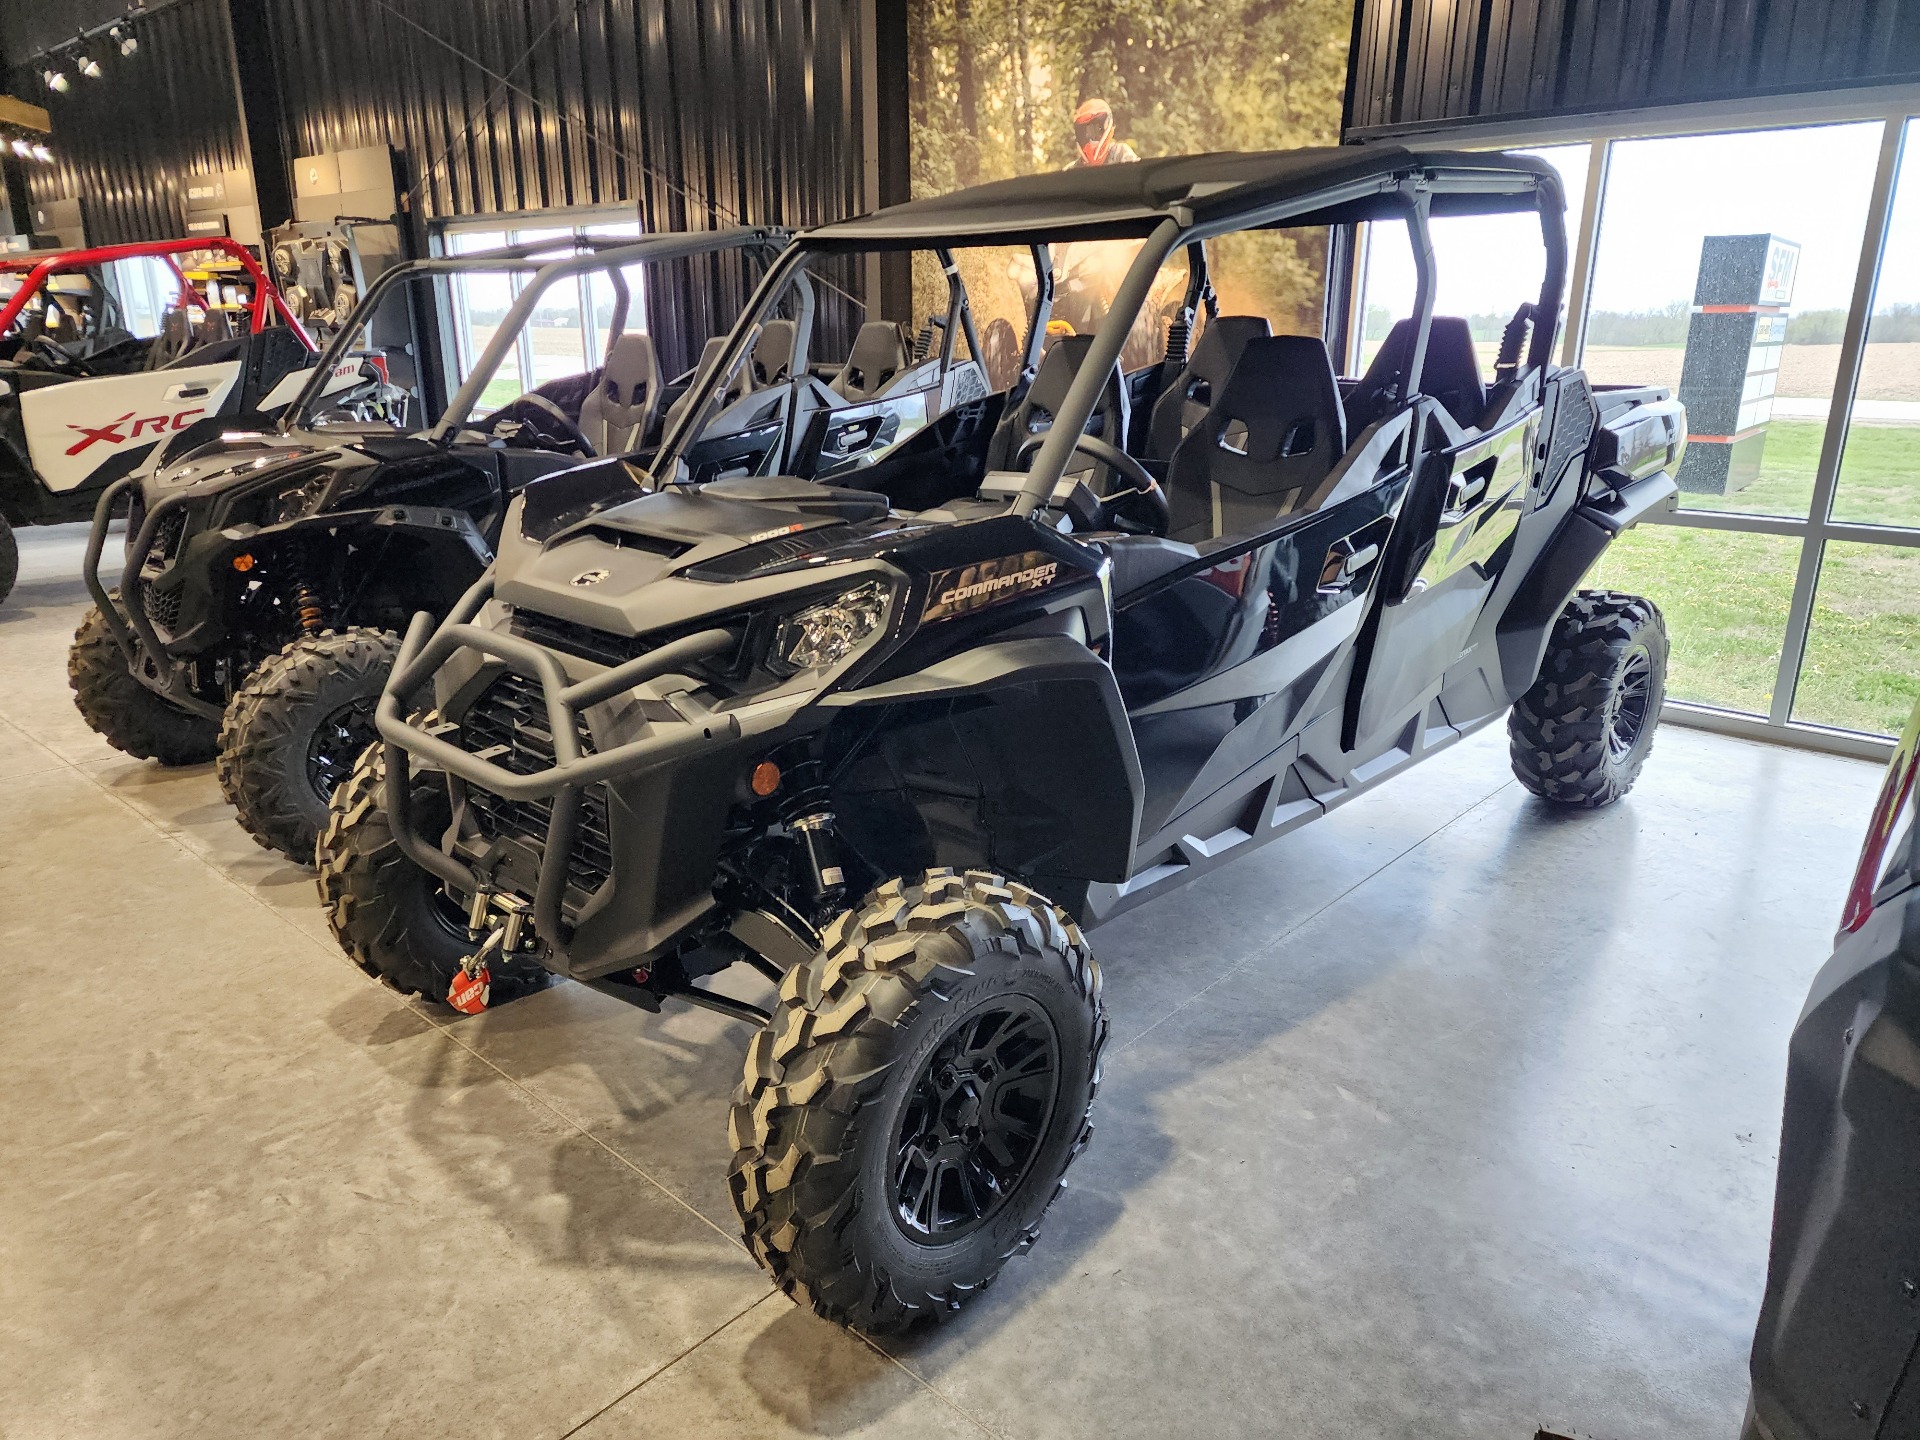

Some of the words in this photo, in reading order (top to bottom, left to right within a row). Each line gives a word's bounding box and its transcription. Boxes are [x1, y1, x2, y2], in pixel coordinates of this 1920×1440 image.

[65, 408, 205, 456] XRC
[750, 523, 804, 543] 1000R
[940, 562, 1058, 604] COMMANDER
[1030, 573, 1056, 589] XT
